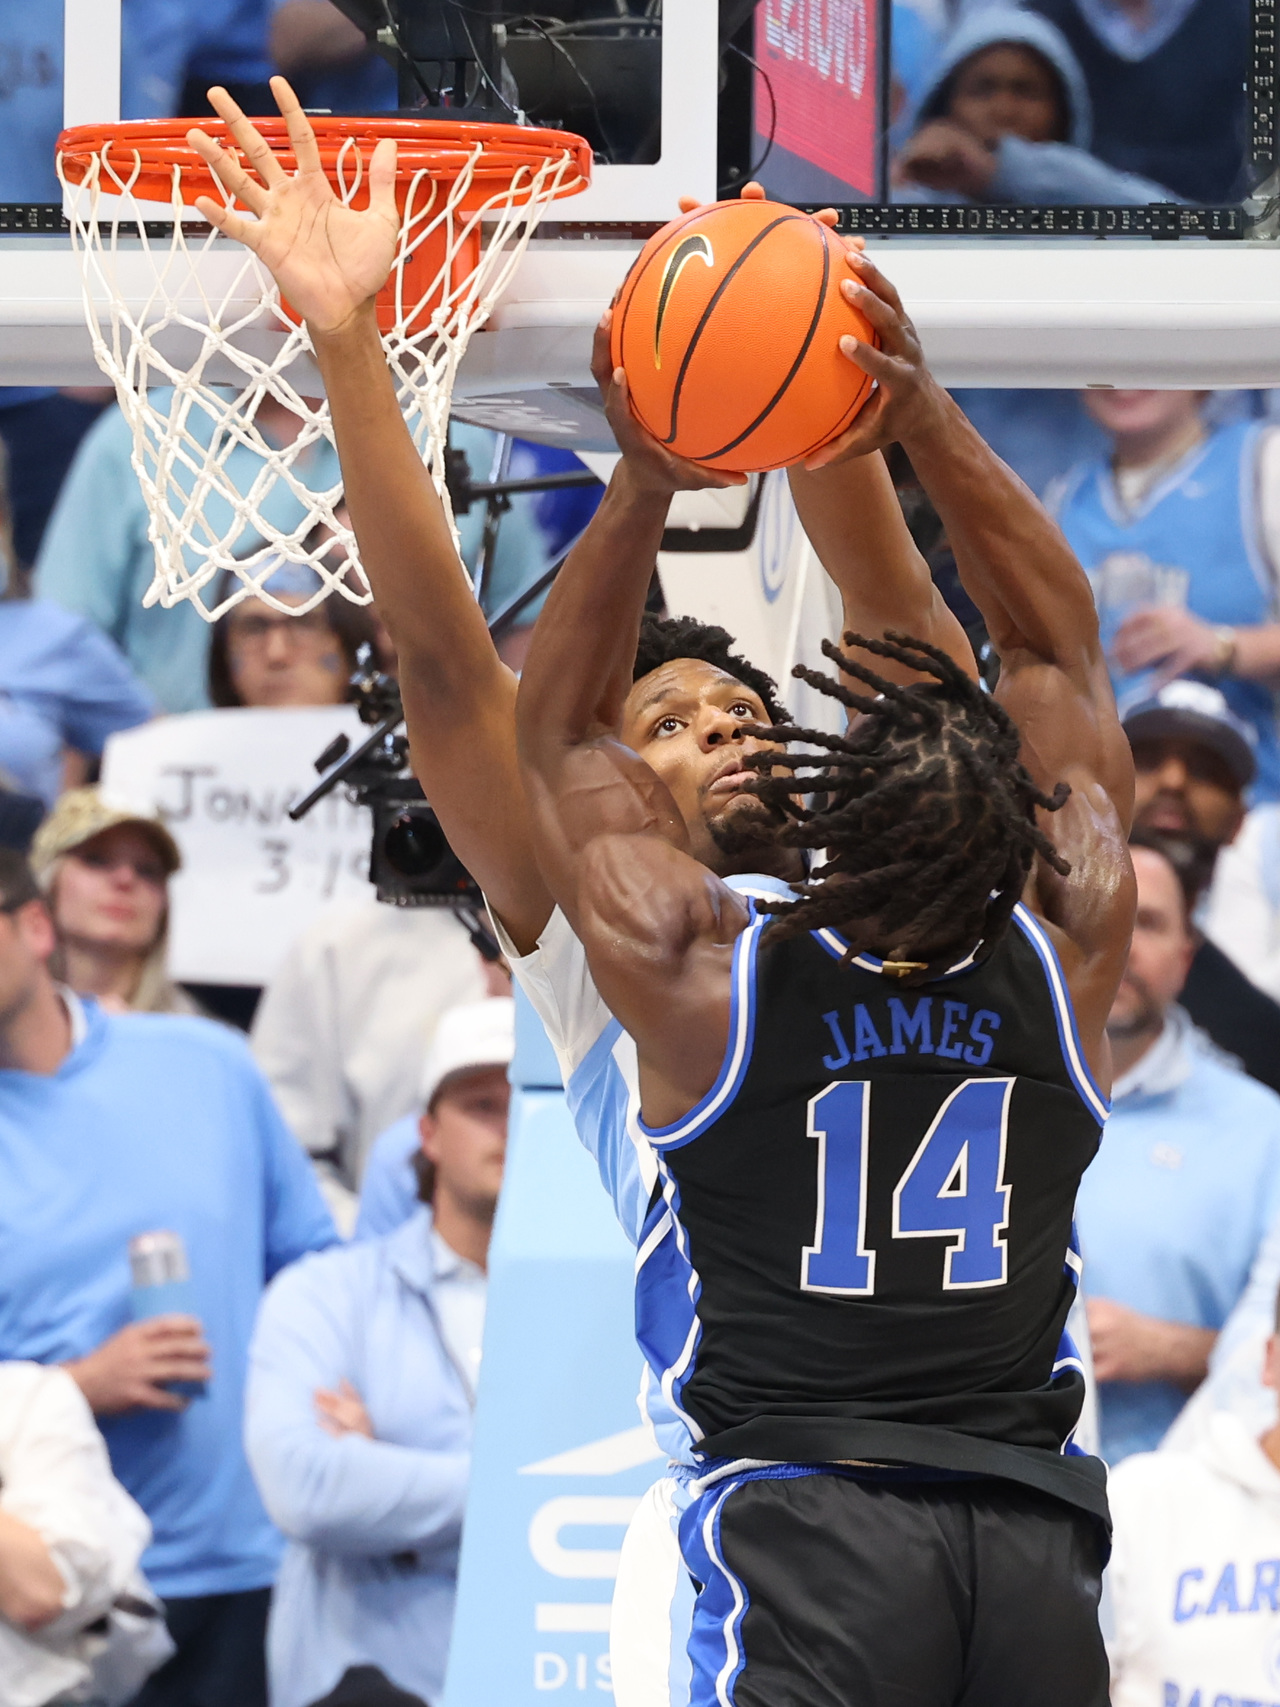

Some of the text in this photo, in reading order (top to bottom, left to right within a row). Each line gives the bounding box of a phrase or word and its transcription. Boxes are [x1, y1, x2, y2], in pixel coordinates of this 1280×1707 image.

[822, 997, 1002, 1071] JAMES
[800, 1076, 1018, 1296] 14
[1173, 1559, 1280, 1624] CAR
